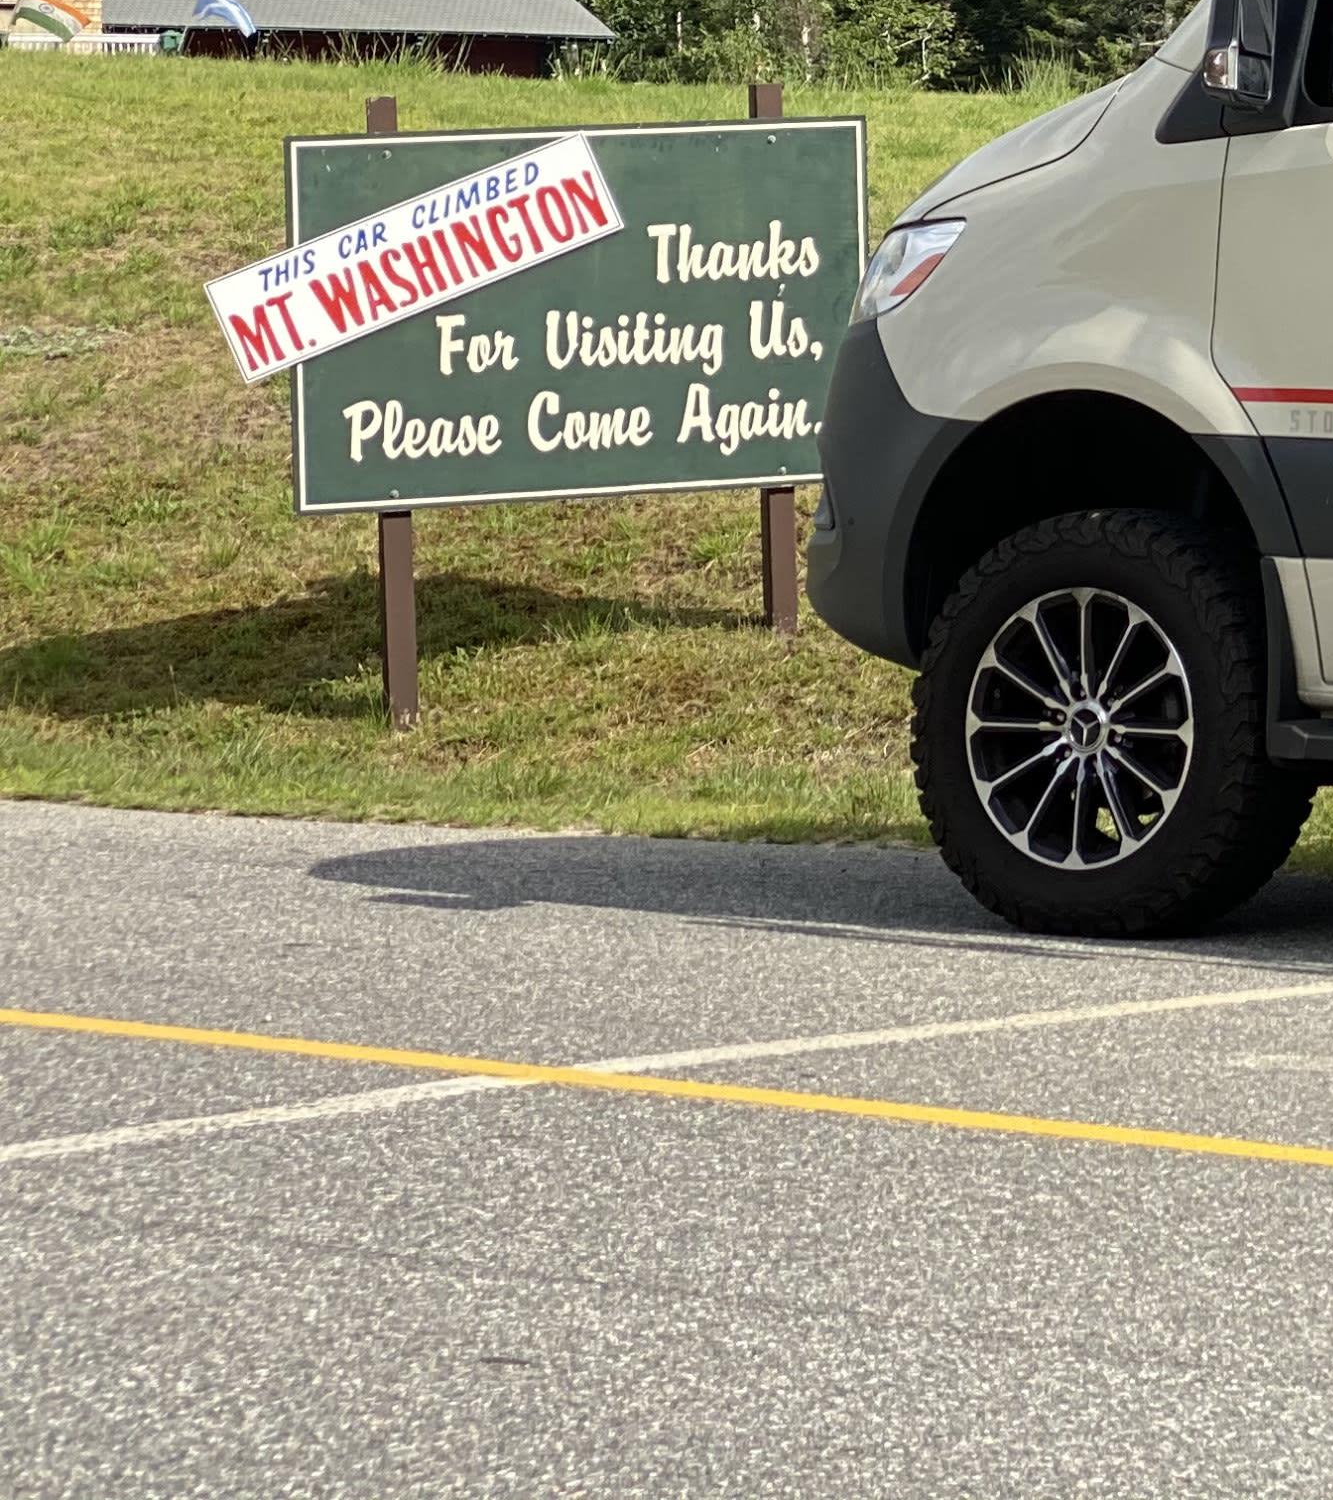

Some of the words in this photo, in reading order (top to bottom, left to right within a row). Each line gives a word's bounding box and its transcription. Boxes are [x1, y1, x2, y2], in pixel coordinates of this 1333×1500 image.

[258, 249, 316, 291] THIS
[338, 222, 387, 259] CAR
[411, 161, 540, 230] CLIMBED
[647, 219, 821, 284] Thanks
[228, 291, 317, 372] MT.
[308, 169, 609, 335] WASHINGTON
[435, 314, 520, 376] For
[545, 309, 724, 376] Visiting
[749, 299, 825, 362] Us,
[342, 399, 502, 462] Please
[527, 390, 654, 453] Come
[676, 383, 823, 456] Again.
